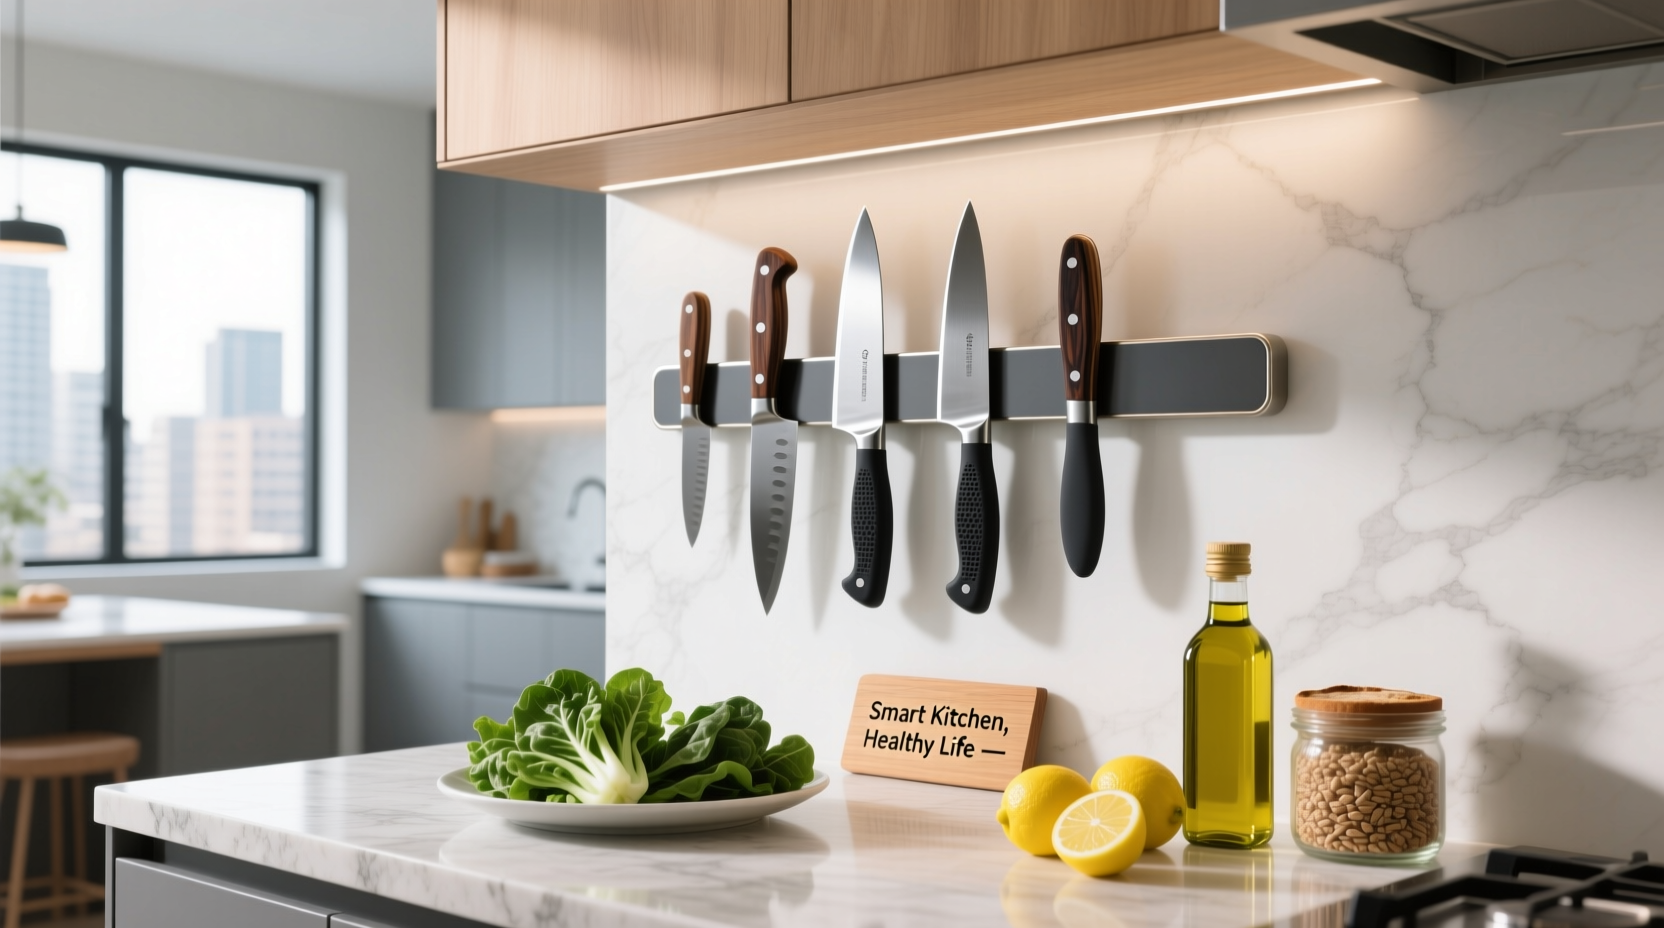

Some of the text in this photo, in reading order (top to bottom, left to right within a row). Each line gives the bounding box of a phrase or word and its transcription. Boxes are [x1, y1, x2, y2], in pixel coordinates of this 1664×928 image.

[869, 701, 1009, 736] Smart Kitchen,
[863, 729, 935, 758] Healthy
[939, 735, 975, 758] Life
